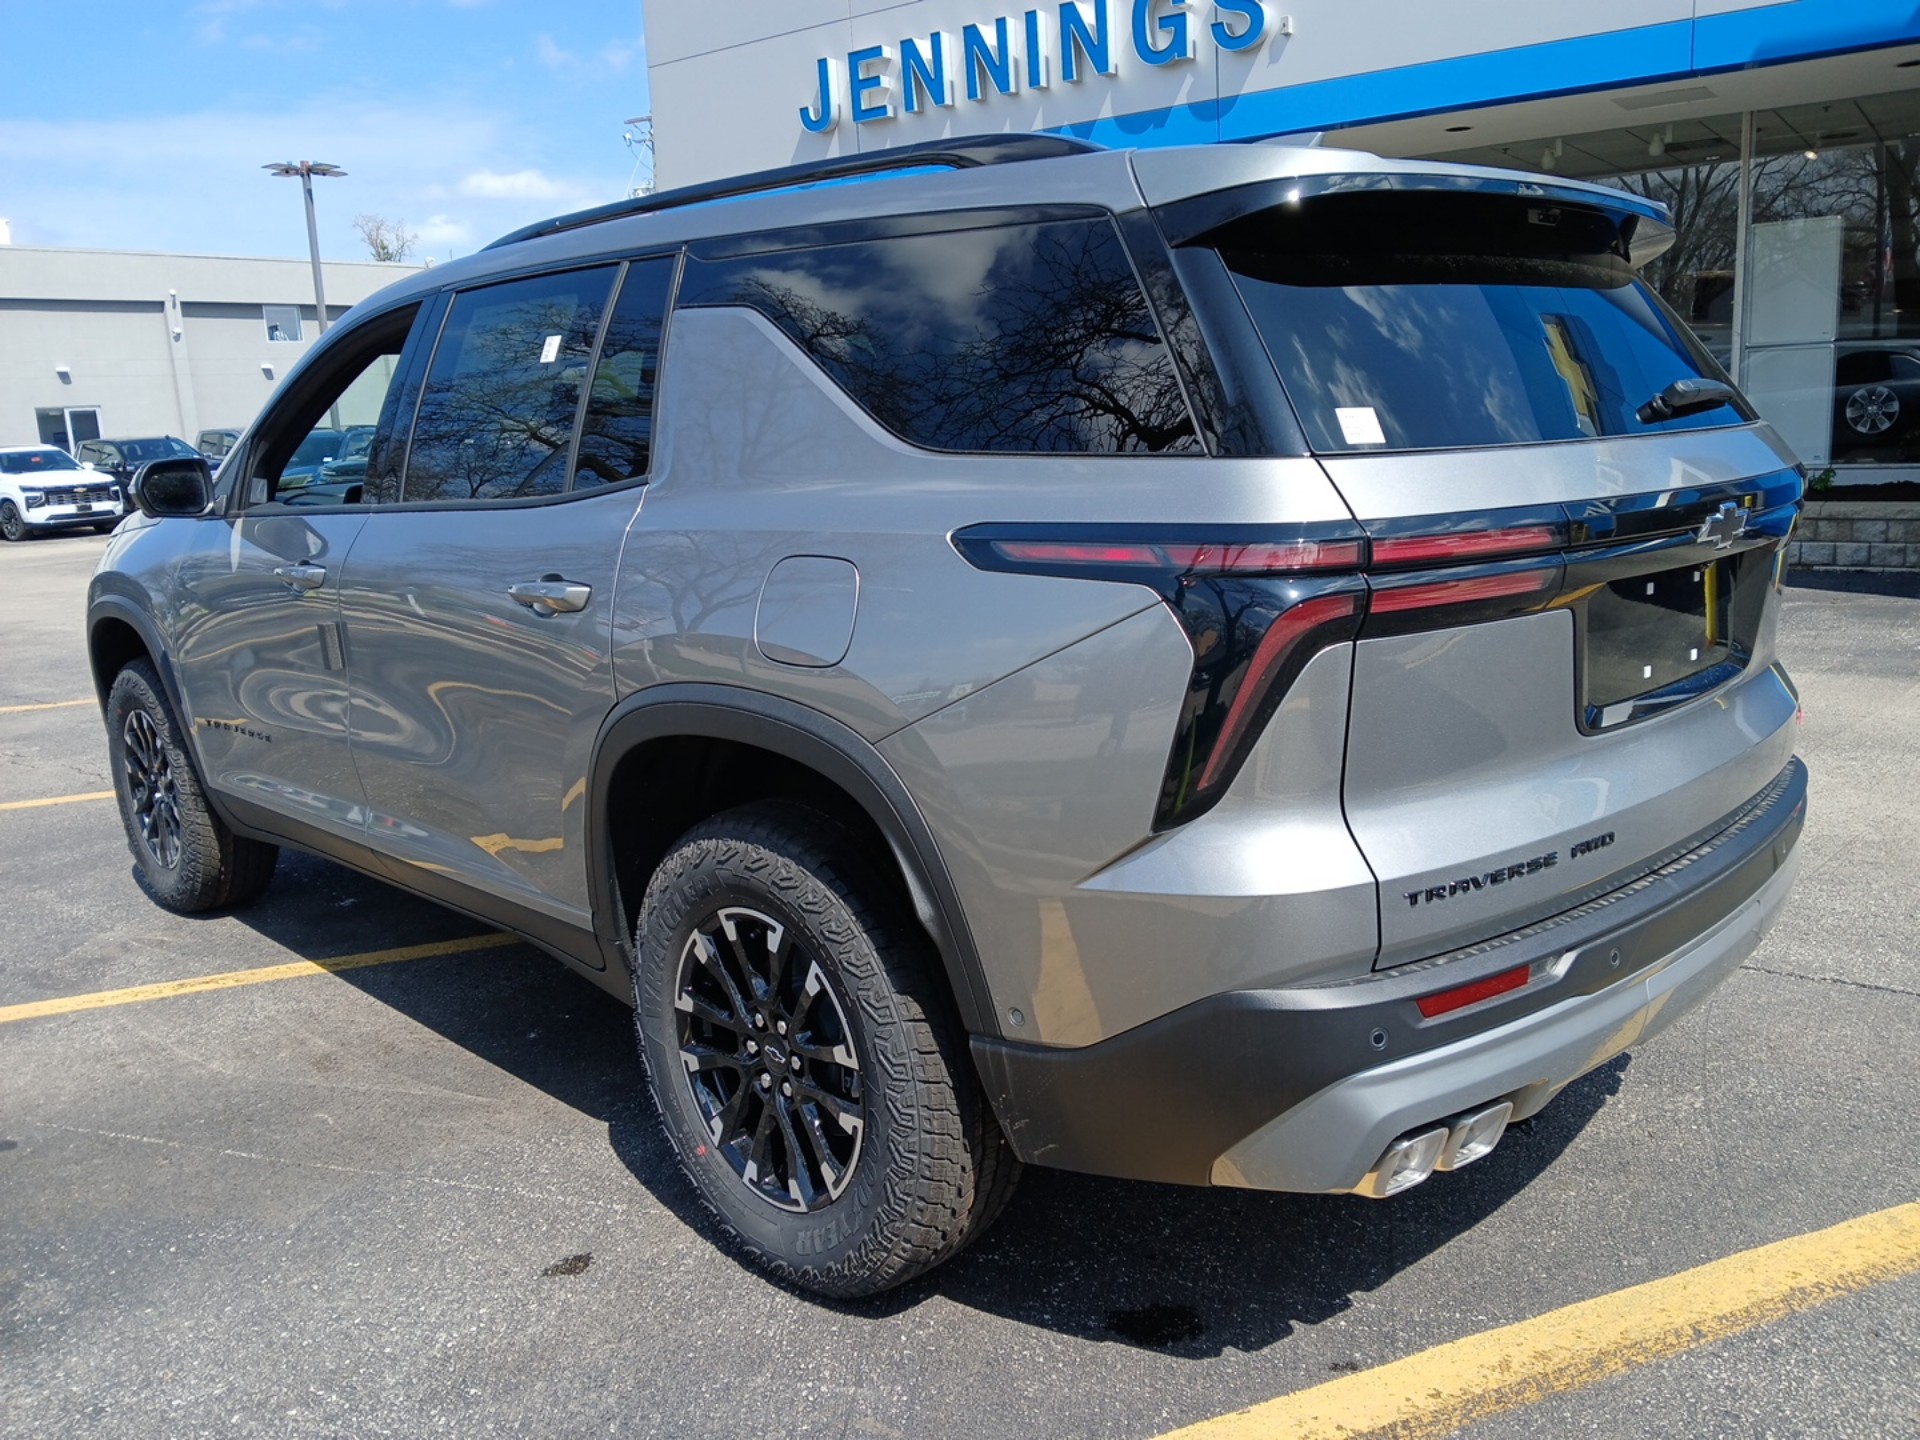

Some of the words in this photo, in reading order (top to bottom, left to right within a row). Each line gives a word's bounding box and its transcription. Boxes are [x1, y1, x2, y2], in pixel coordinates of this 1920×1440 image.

[799, 0, 1269, 133] JENNINGS
[1402, 851, 1559, 908] TRAVERSE
[1570, 831, 1616, 860] AWD
